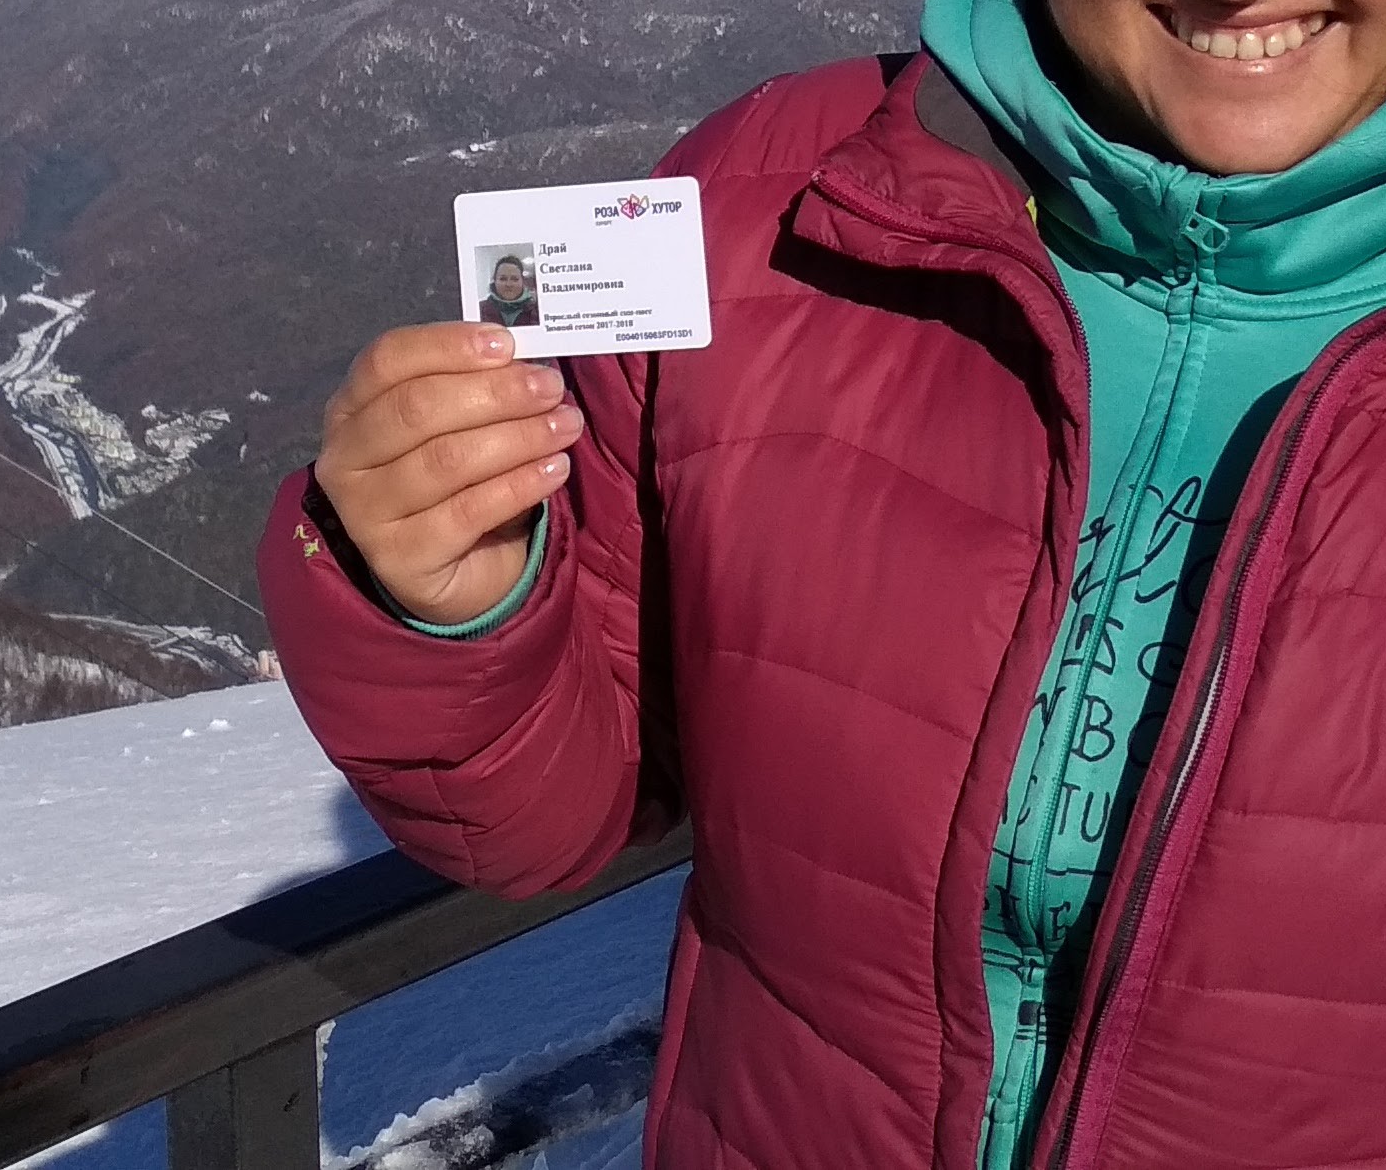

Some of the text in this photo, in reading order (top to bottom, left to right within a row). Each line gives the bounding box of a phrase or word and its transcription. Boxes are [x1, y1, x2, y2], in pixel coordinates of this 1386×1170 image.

[594, 201, 682, 218] РОЗА ХУТОР
[538, 242, 567, 256] Драй
[539, 263, 593, 274] Светлана
[541, 280, 624, 294] Владимировна
[596, 319, 634, 330] 2017-2018
